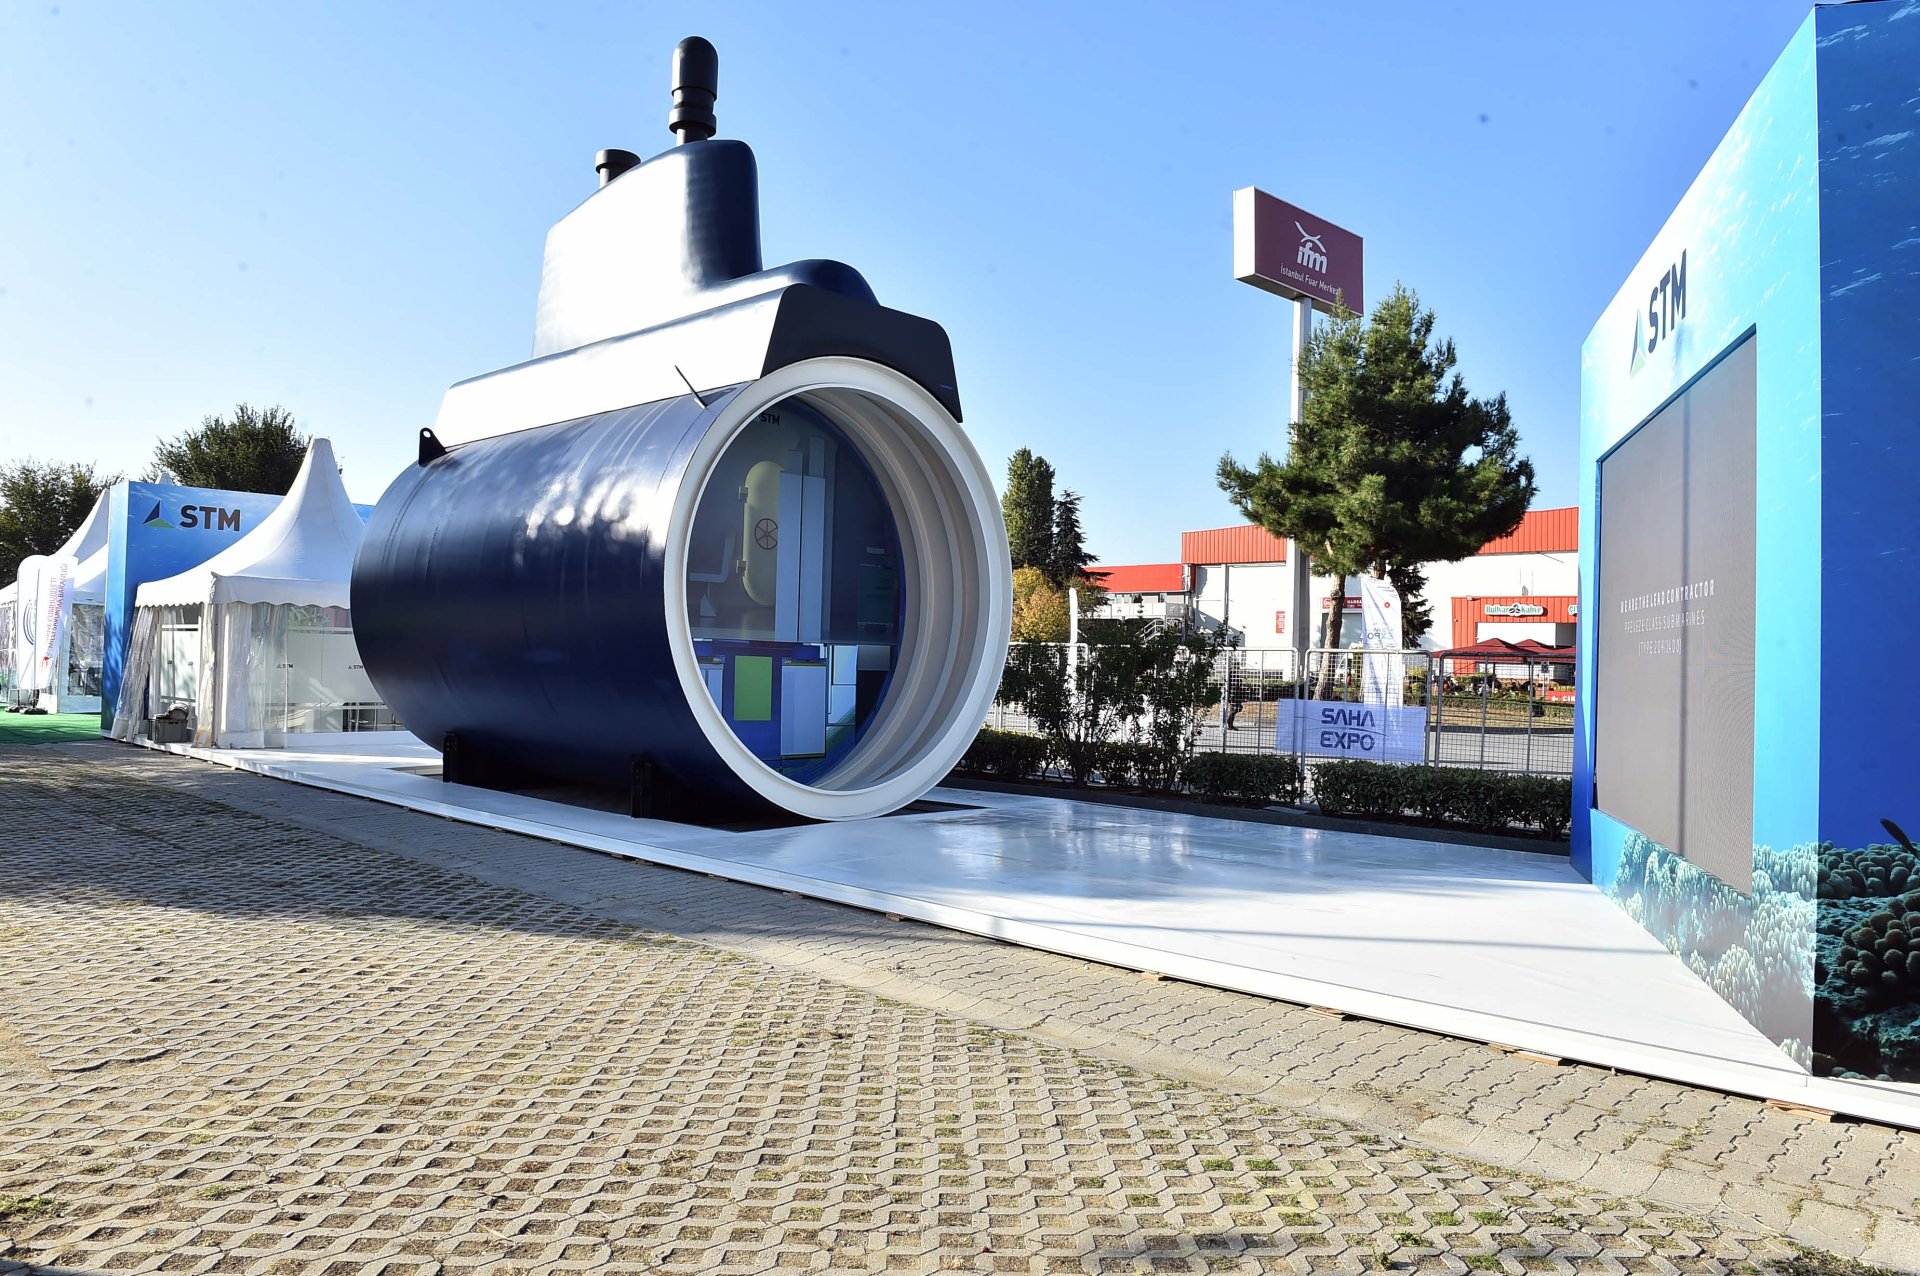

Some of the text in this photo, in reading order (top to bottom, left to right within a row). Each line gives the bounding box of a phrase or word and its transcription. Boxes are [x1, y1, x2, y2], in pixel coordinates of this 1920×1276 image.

[1297, 241, 1328, 274] ifm
[1280, 262, 1304, 283] İstanbul
[1305, 274, 1318, 288] Fuar
[1648, 248, 1687, 354] STM
[760, 413, 780, 425] STM
[179, 504, 241, 532] STM
[1639, 595, 1649, 609] THE
[1650, 591, 1665, 607] LEAD
[1666, 579, 1715, 604] CONTRACTOR
[1645, 616, 1661, 631] CLASS
[1663, 609, 1705, 629] SUBMARINES
[1321, 707, 1376, 728] SAHA
[1320, 730, 1376, 751] EXPO
